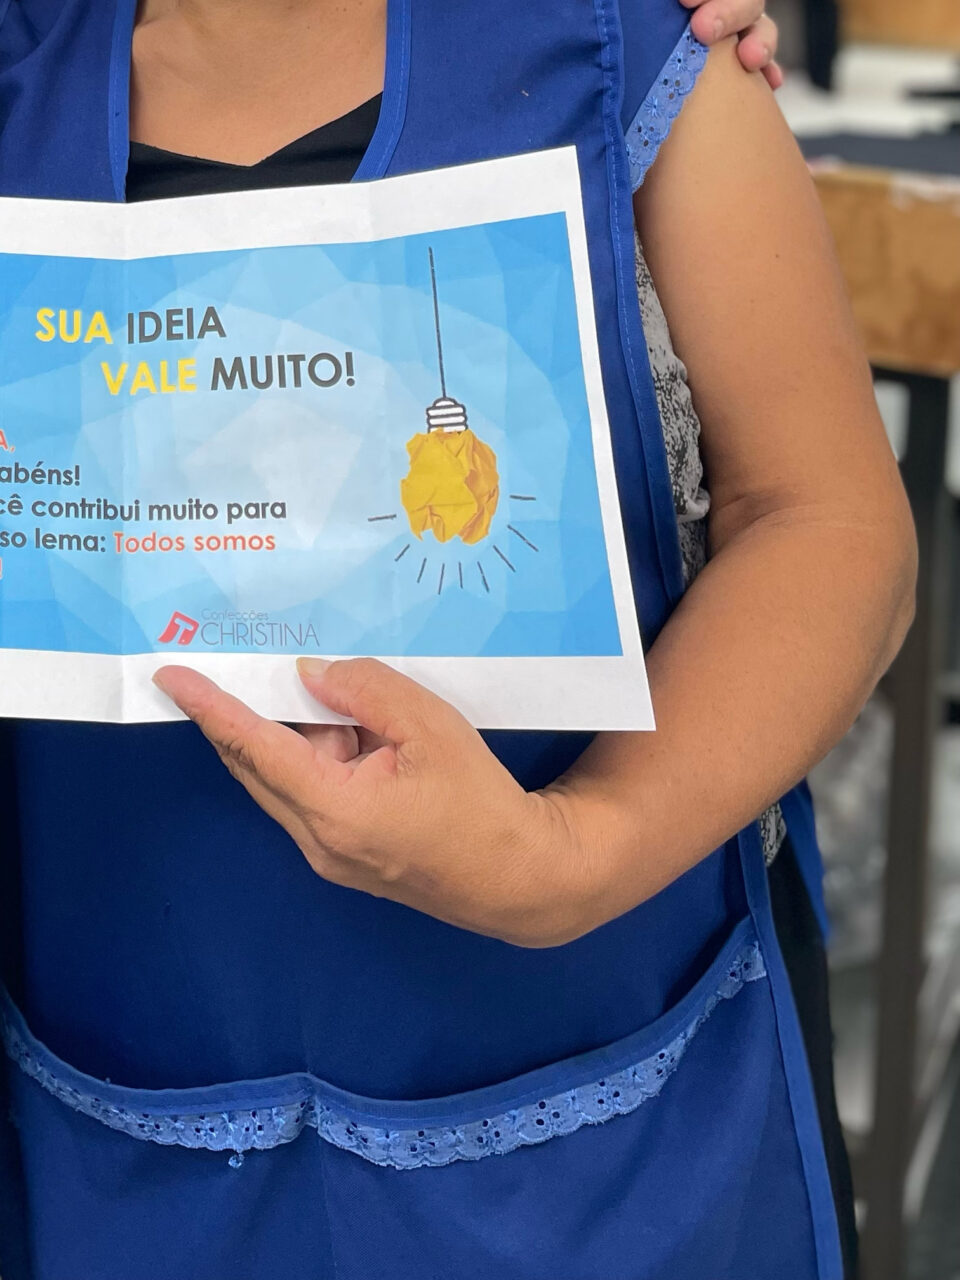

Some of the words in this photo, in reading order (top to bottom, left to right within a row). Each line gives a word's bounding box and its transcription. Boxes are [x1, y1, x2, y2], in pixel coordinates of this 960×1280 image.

[35, 307, 114, 345] SUA
[127, 306, 227, 344] IDEIA
[100, 358, 197, 396] VALE
[210, 351, 356, 391] MUITO!
[31, 497, 140, 522] contribui
[148, 497, 219, 521] muito
[226, 501, 287, 524] para
[35, 527, 106, 553] lema:
[113, 531, 185, 554] Todos
[193, 533, 276, 551] somos
[200, 622, 321, 647] CHRISTINA
